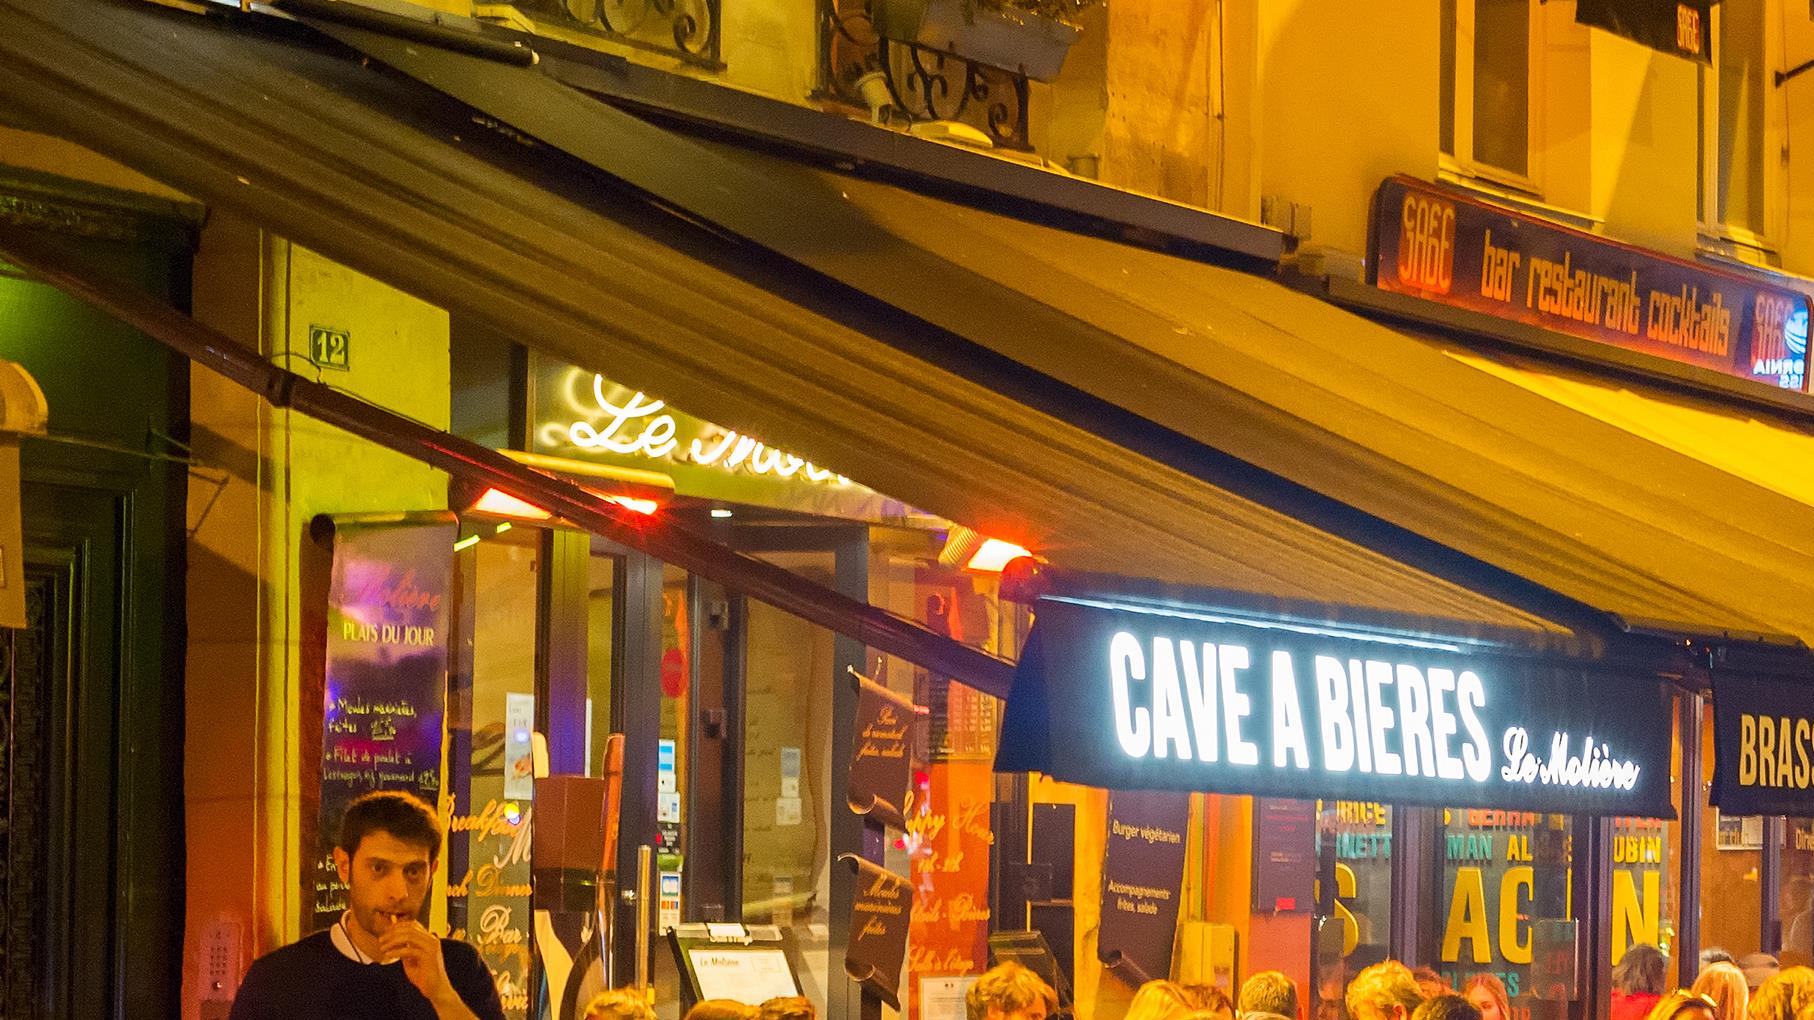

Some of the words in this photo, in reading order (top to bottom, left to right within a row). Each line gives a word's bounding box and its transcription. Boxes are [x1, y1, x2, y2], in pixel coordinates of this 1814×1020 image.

[1481, 229, 1520, 302] bar
[1527, 251, 1641, 335] restaurant
[1648, 282, 1731, 357] cocktails
[317, 331, 345, 364] 12
[344, 621, 378, 643] PLATS
[382, 625, 400, 643] DU
[404, 627, 434, 646] JOUR
[1110, 631, 1258, 766] CAVE
[1272, 650, 1310, 769] A
[1315, 656, 1492, 783] BIERES
[1501, 726, 1538, 784] Le
[1539, 731, 1641, 791] Molière
[1113, 819, 1139, 840] Burger
[477, 904, 522, 945] Bar
